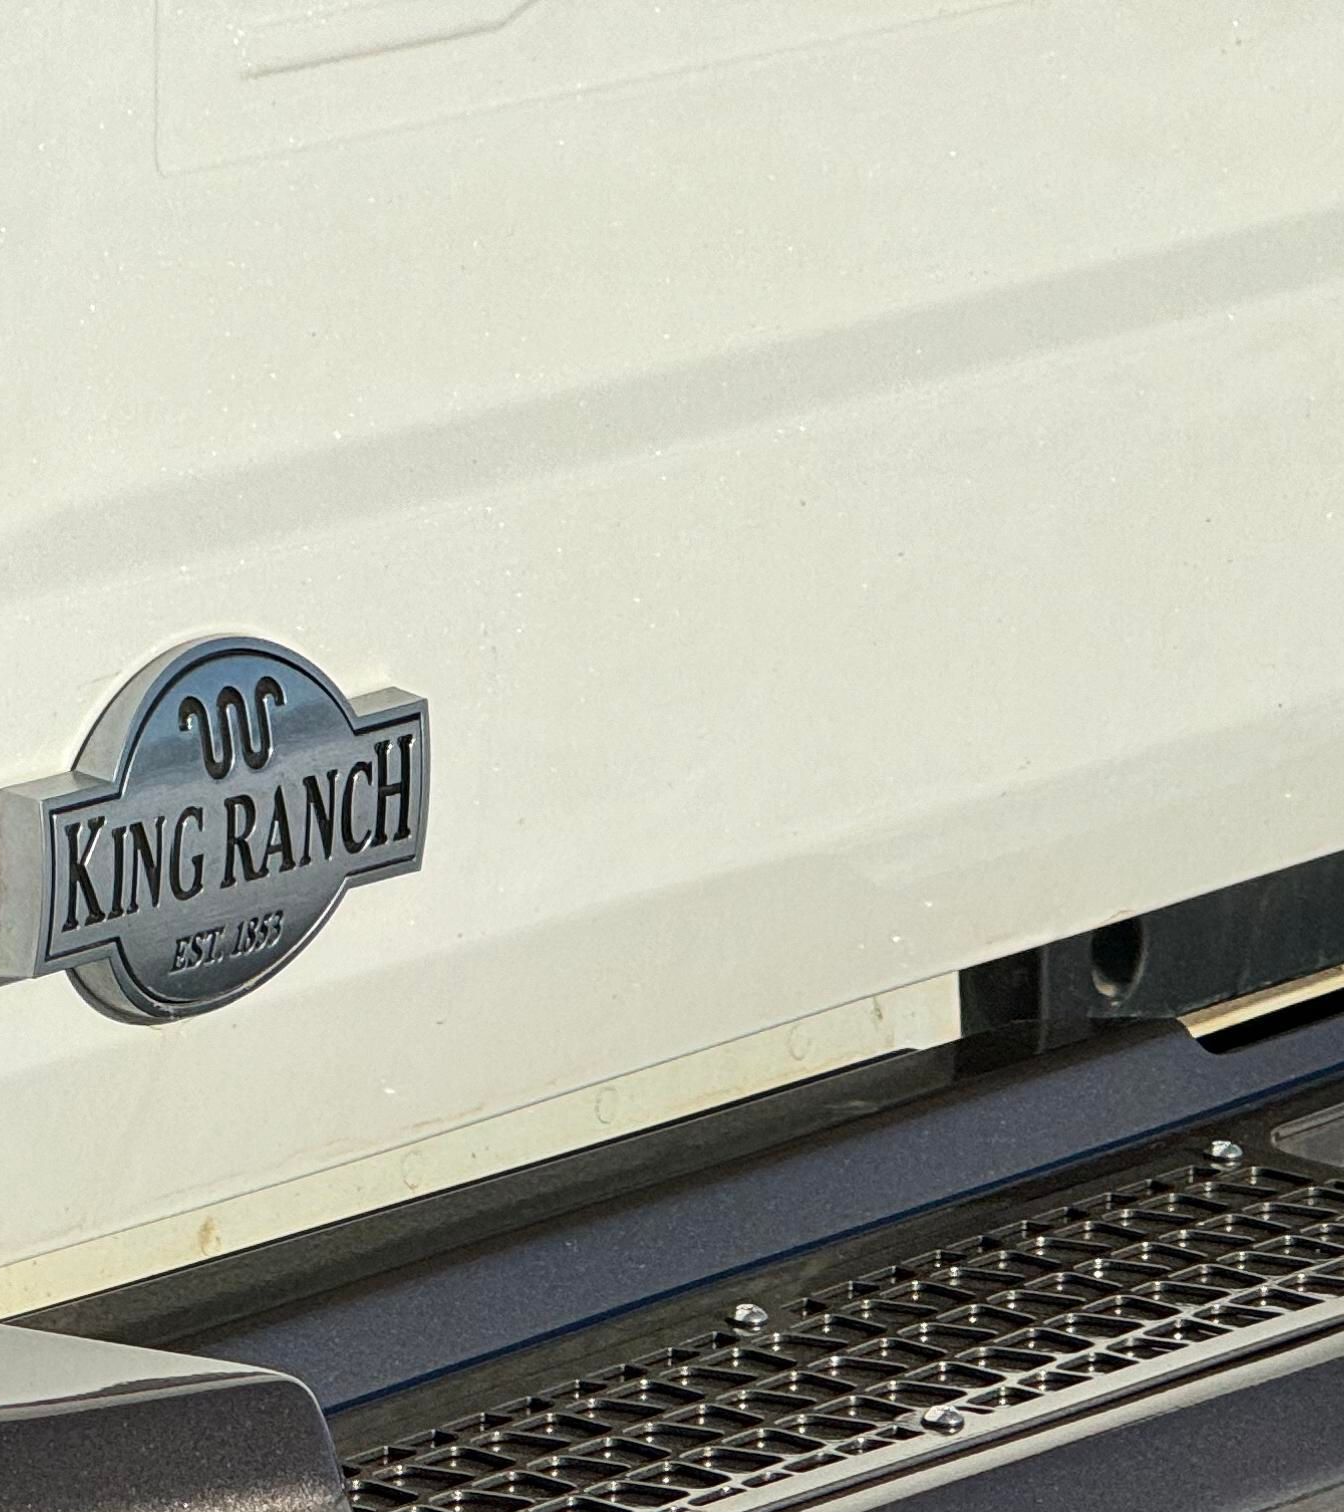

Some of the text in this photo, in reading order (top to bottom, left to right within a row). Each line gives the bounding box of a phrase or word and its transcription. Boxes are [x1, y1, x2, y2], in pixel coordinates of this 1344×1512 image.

[61, 733, 415, 932] KING RANCH
[168, 910, 284, 973] EST. 1853
